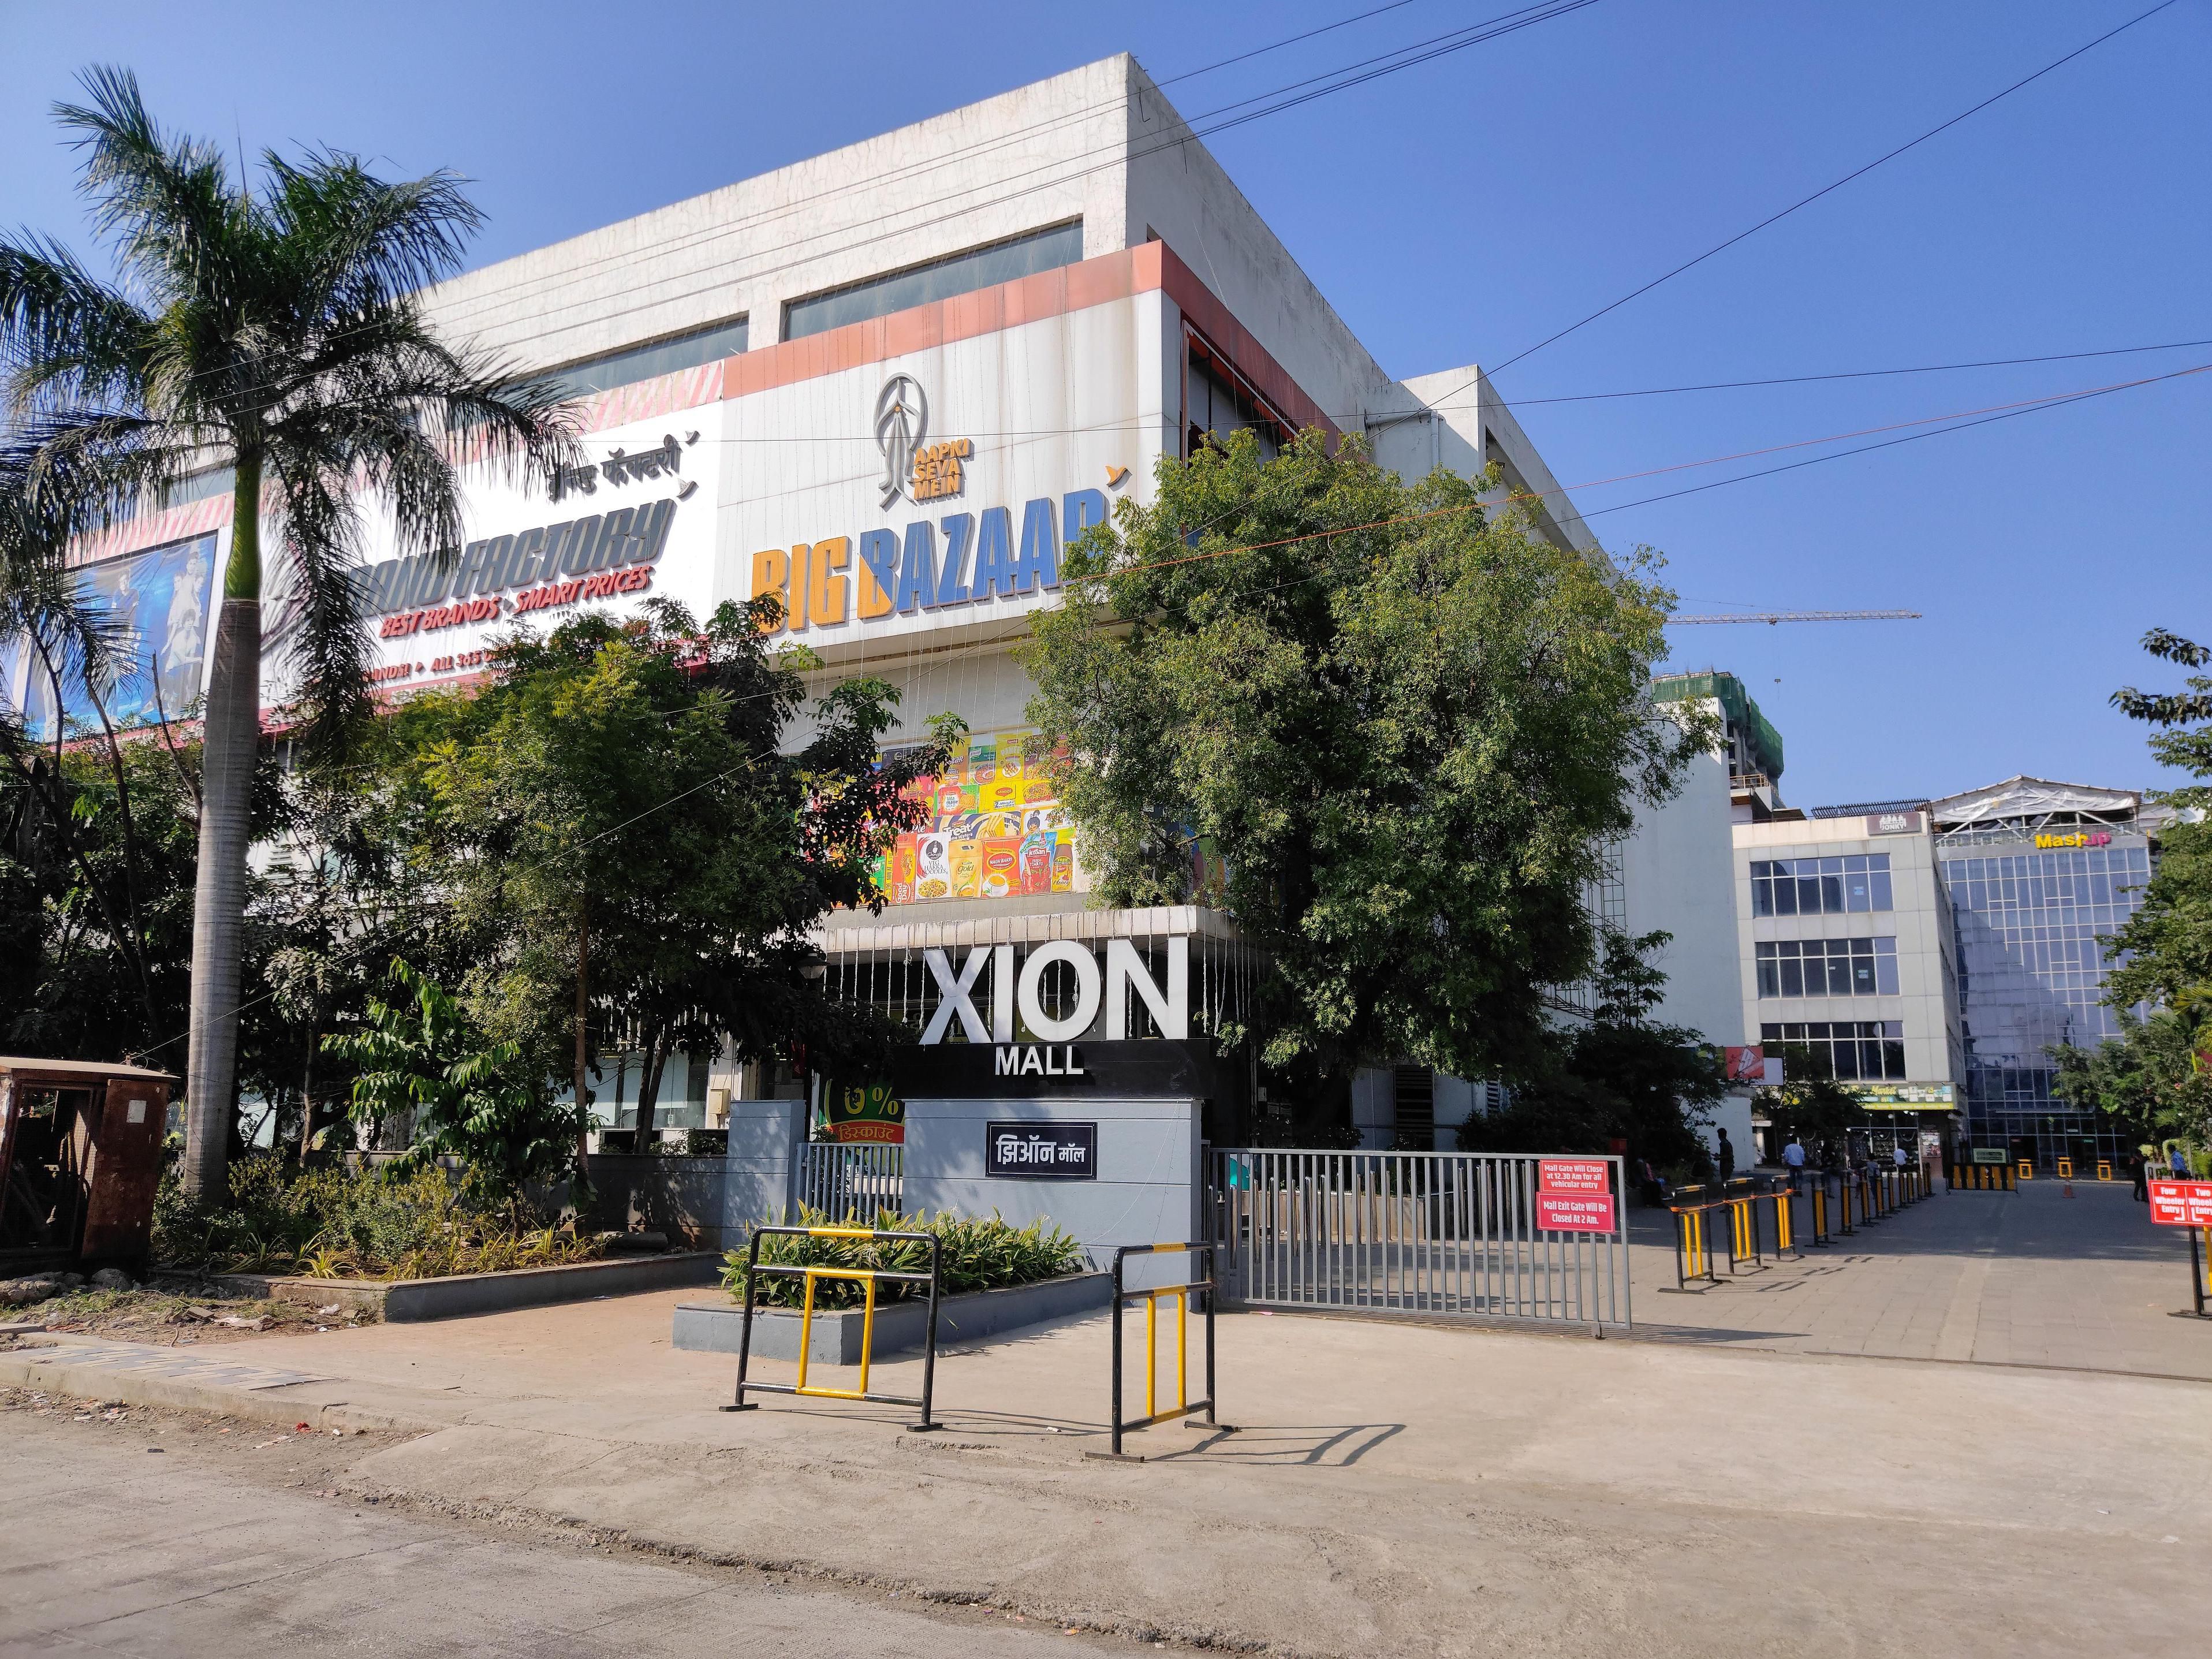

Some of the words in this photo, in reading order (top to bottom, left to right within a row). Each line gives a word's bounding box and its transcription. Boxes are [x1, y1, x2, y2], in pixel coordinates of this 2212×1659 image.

[914, 438, 971, 466] AAPKI
[914, 458, 962, 482] SEVA
[914, 475, 961, 501] MEIN
[345, 546, 461, 618] RAND
[452, 498, 678, 599] FACTORY
[751, 536, 851, 635] BIG
[379, 611, 424, 639] BEST
[420, 596, 502, 631] BRANDS
[512, 579, 585, 614] SMART
[583, 565, 652, 599] PRICES
[431, 655, 453, 672] ALL
[456, 650, 482, 668] 365
[919, 937, 1189, 1045] XION
[995, 1046, 1084, 1075] MALL
[838, 1123, 895, 1141] डिस्काउंट
[996, 1134, 1057, 1165] झिऑन
[1058, 1143, 1086, 1162] मॉल
[2155, 1196, 2185, 1205] Wheeler
[2160, 1187, 2177, 1195] Four
[2188, 1197, 2212, 1206] Wheel
[2195, 1188, 2211, 1197] Two
[1543, 1201, 1557, 1210] Mall
[1558, 1202, 1570, 1211] Exit
[1571, 1202, 1585, 1211] Gate
[1586, 1203, 1598, 1212] Will
[1598, 1203, 1607, 1213] Be
[2161, 1205, 2180, 1214] Entry
[1552, 1213, 1572, 1223] Closed
[1573, 1214, 1581, 1224] At
[1581, 1215, 1586, 1224] 2
[1587, 1216, 1599, 1225] Am.
